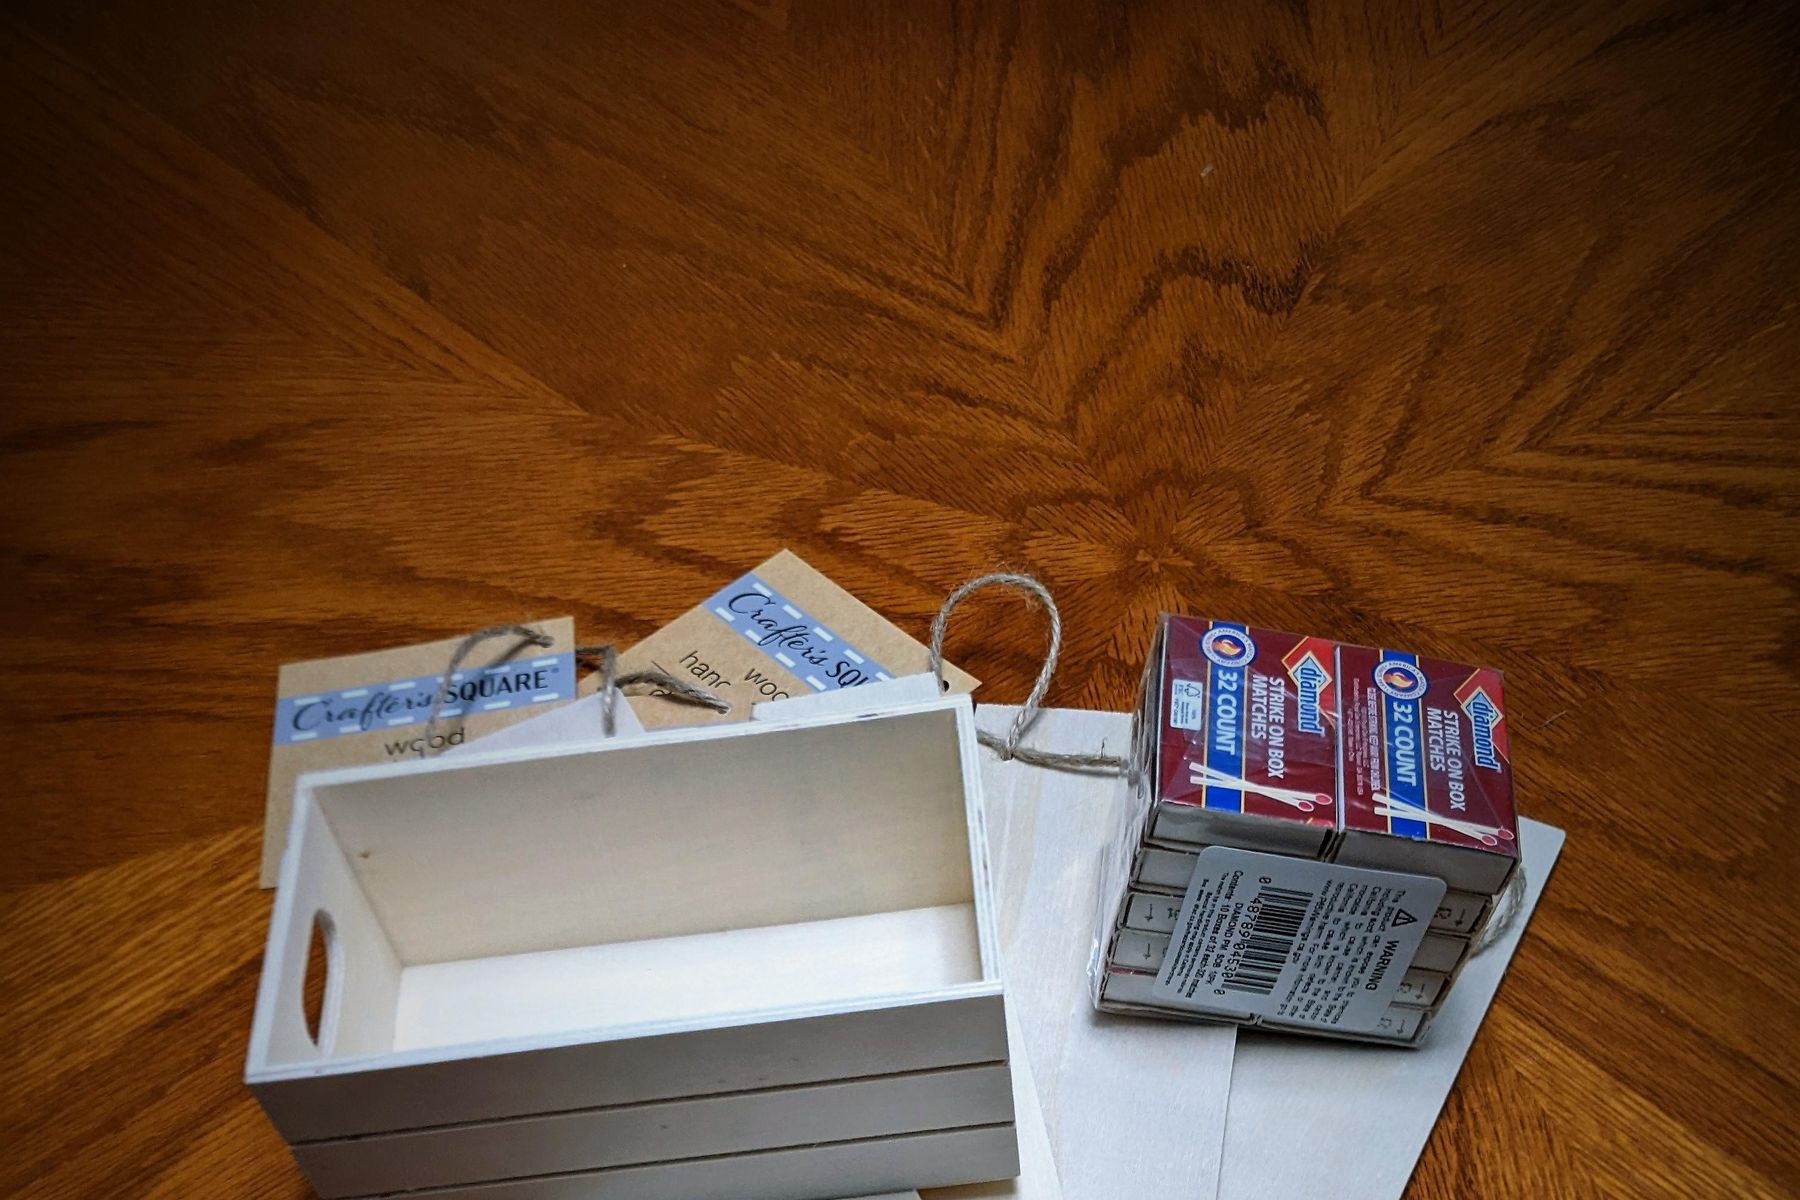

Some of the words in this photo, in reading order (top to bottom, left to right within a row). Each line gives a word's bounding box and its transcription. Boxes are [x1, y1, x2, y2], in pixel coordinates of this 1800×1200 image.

[729, 592, 827, 666] Crafter's
[289, 690, 432, 734] Crafter's
[444, 668, 548, 703] SQUARE
[1217, 669, 1237, 692] 32
[1268, 677, 1284, 723] STRIKE
[1298, 664, 1323, 734] diamond
[1215, 692, 1236, 755] COUNT
[1250, 674, 1266, 740] MATCHES
[1393, 701, 1412, 723] 32
[1268, 725, 1283, 746] ON
[1426, 707, 1444, 771] MATCHES
[1443, 710, 1461, 755] STRIKE
[1471, 701, 1499, 768] diamond
[1267, 748, 1283, 779] BOX
[1394, 724, 1416, 786] COUNT
[1447, 757, 1462, 779] ON
[1448, 781, 1465, 811] BOX
[1210, 913, 1228, 935] Boxes
[1218, 904, 1231, 913] 10
[1221, 902, 1246, 938] DIAMOND
[1235, 897, 1264, 938] 48789
[1220, 942, 1246, 978] 04530
[1363, 940, 1402, 991] WARNING
